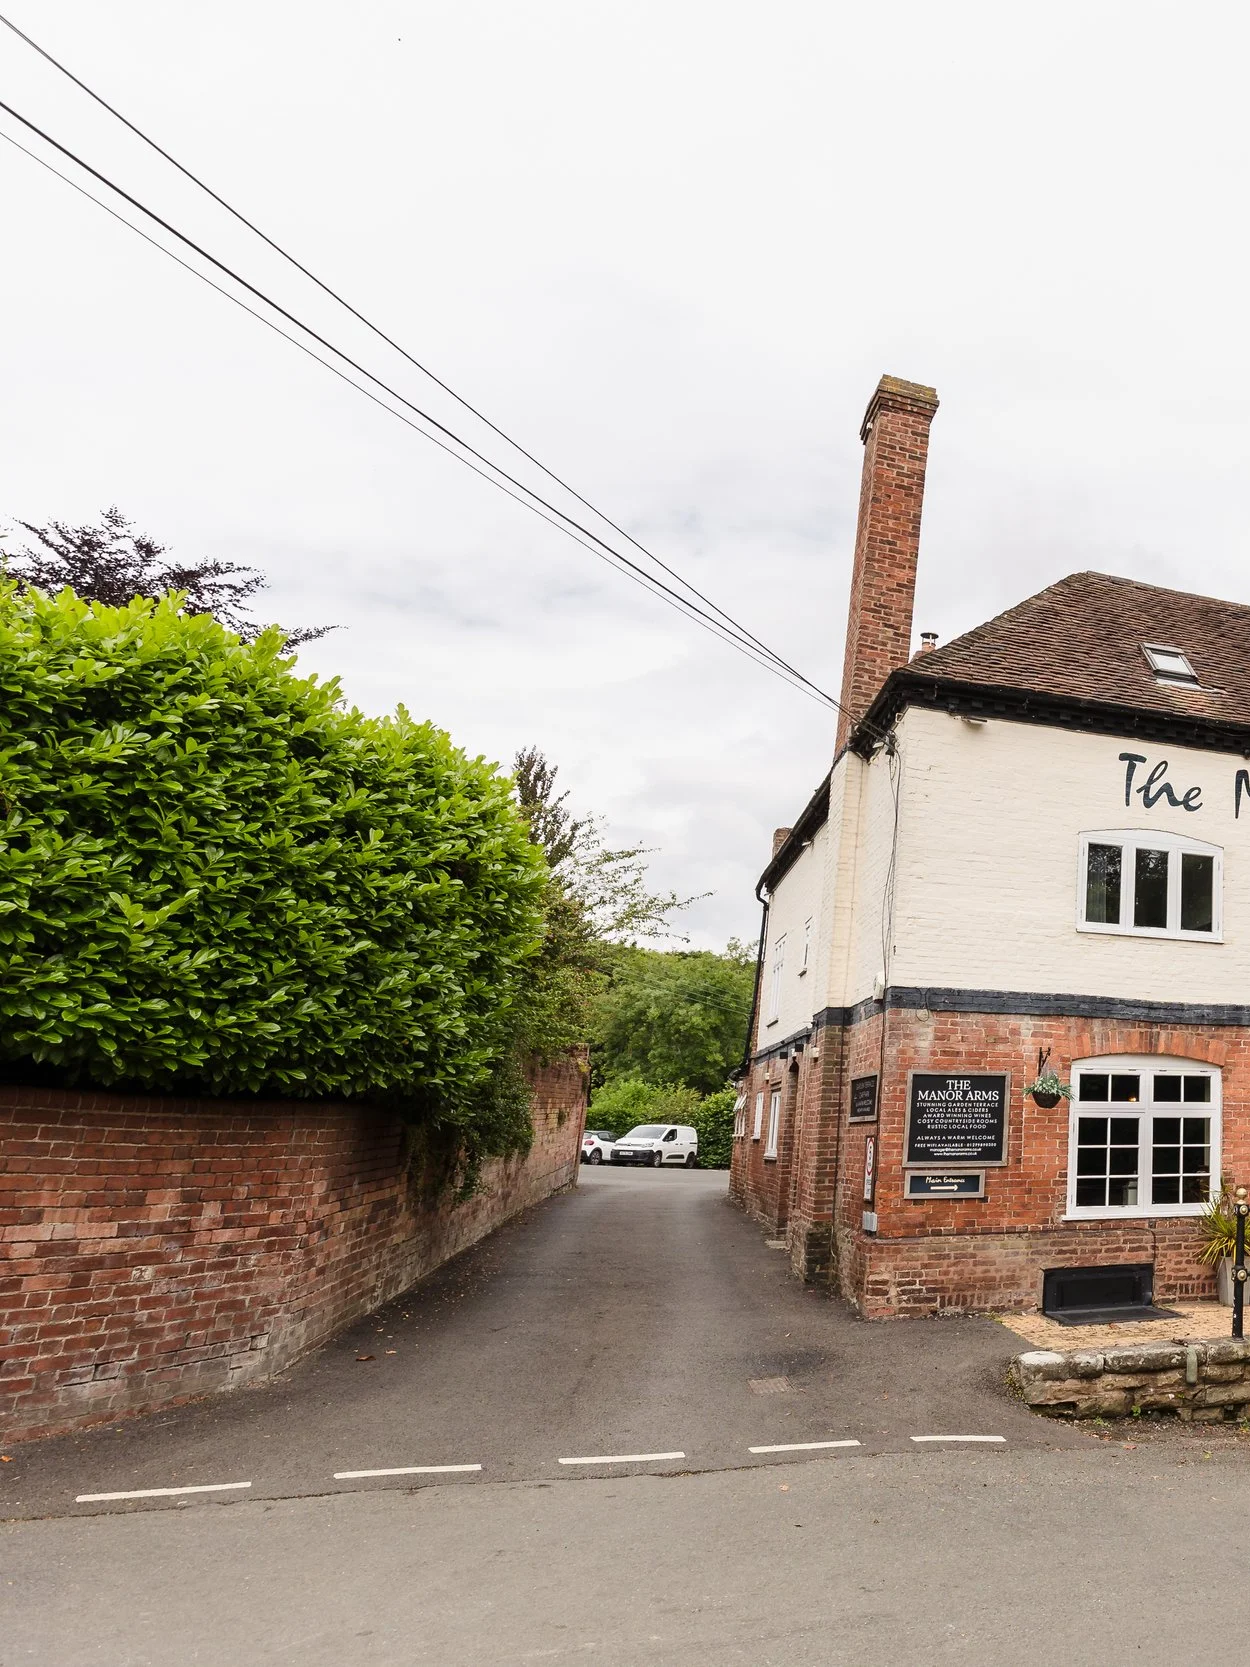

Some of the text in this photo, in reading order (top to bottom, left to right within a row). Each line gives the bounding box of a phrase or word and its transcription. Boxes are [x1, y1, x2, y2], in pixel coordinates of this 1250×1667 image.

[1118, 753, 1204, 813] The
[946, 1080, 971, 1090] THE
[917, 1090, 999, 1101] MANOR ARMS
[925, 1176, 942, 1184] Main
